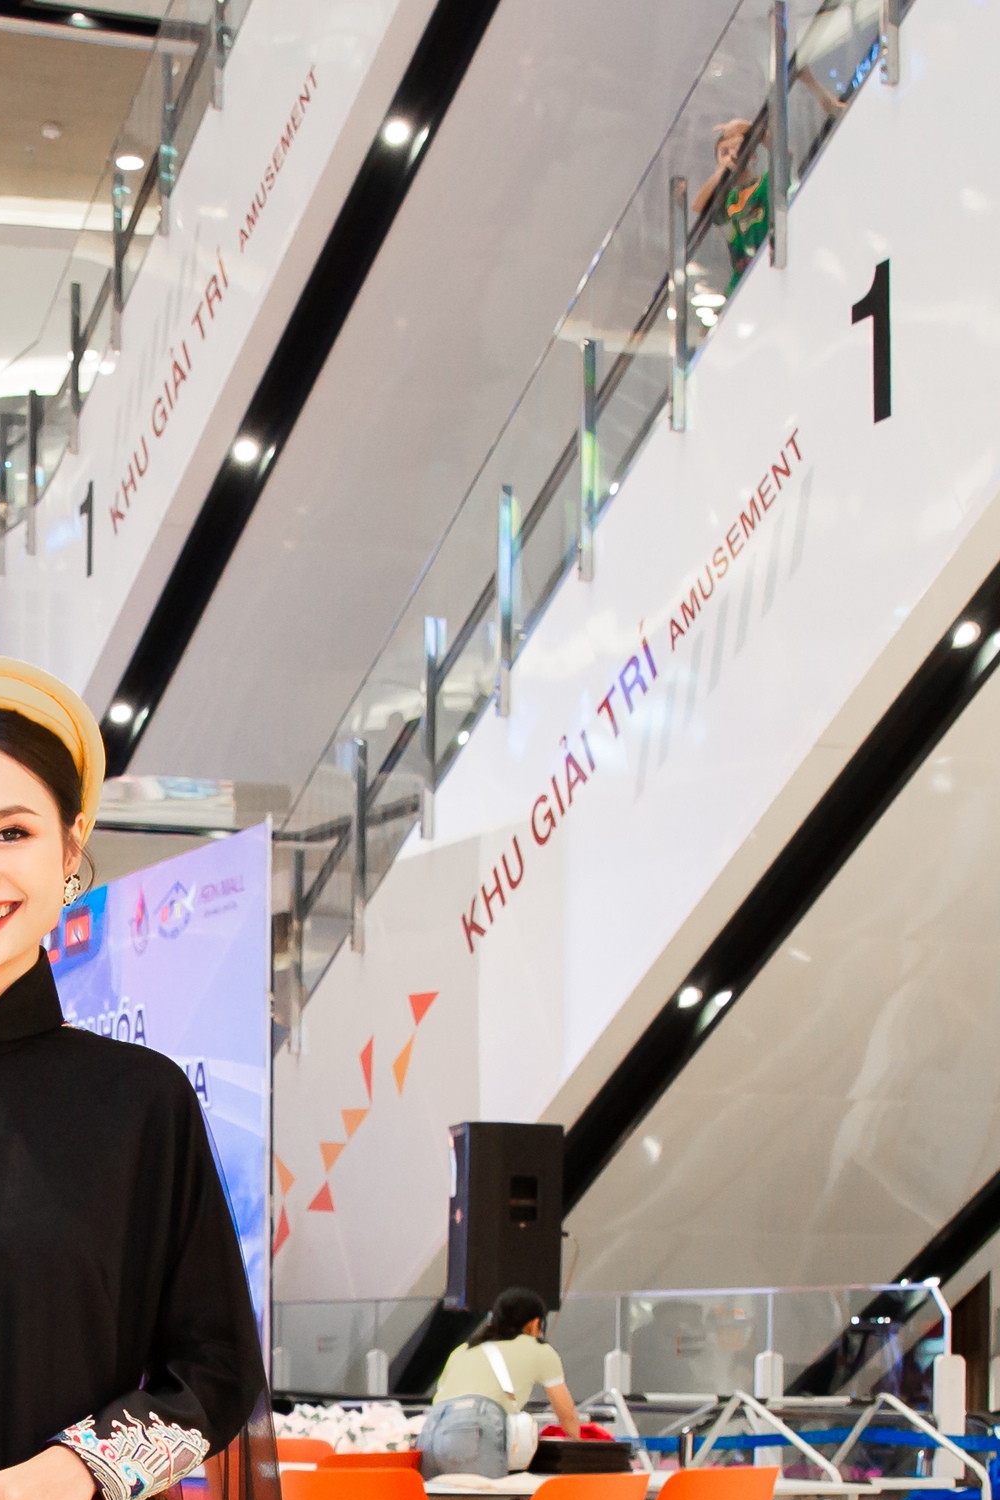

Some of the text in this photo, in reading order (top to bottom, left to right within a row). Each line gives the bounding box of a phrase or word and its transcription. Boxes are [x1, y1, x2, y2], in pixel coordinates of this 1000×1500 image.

[109, 64, 318, 536] KHU GIẢI TRÍ AMUSEMENT
[851, 258, 892, 424] 1
[79, 479, 94, 578] 1
[461, 427, 803, 954] KHU GIẢI TRÍ AMUSEMENT
